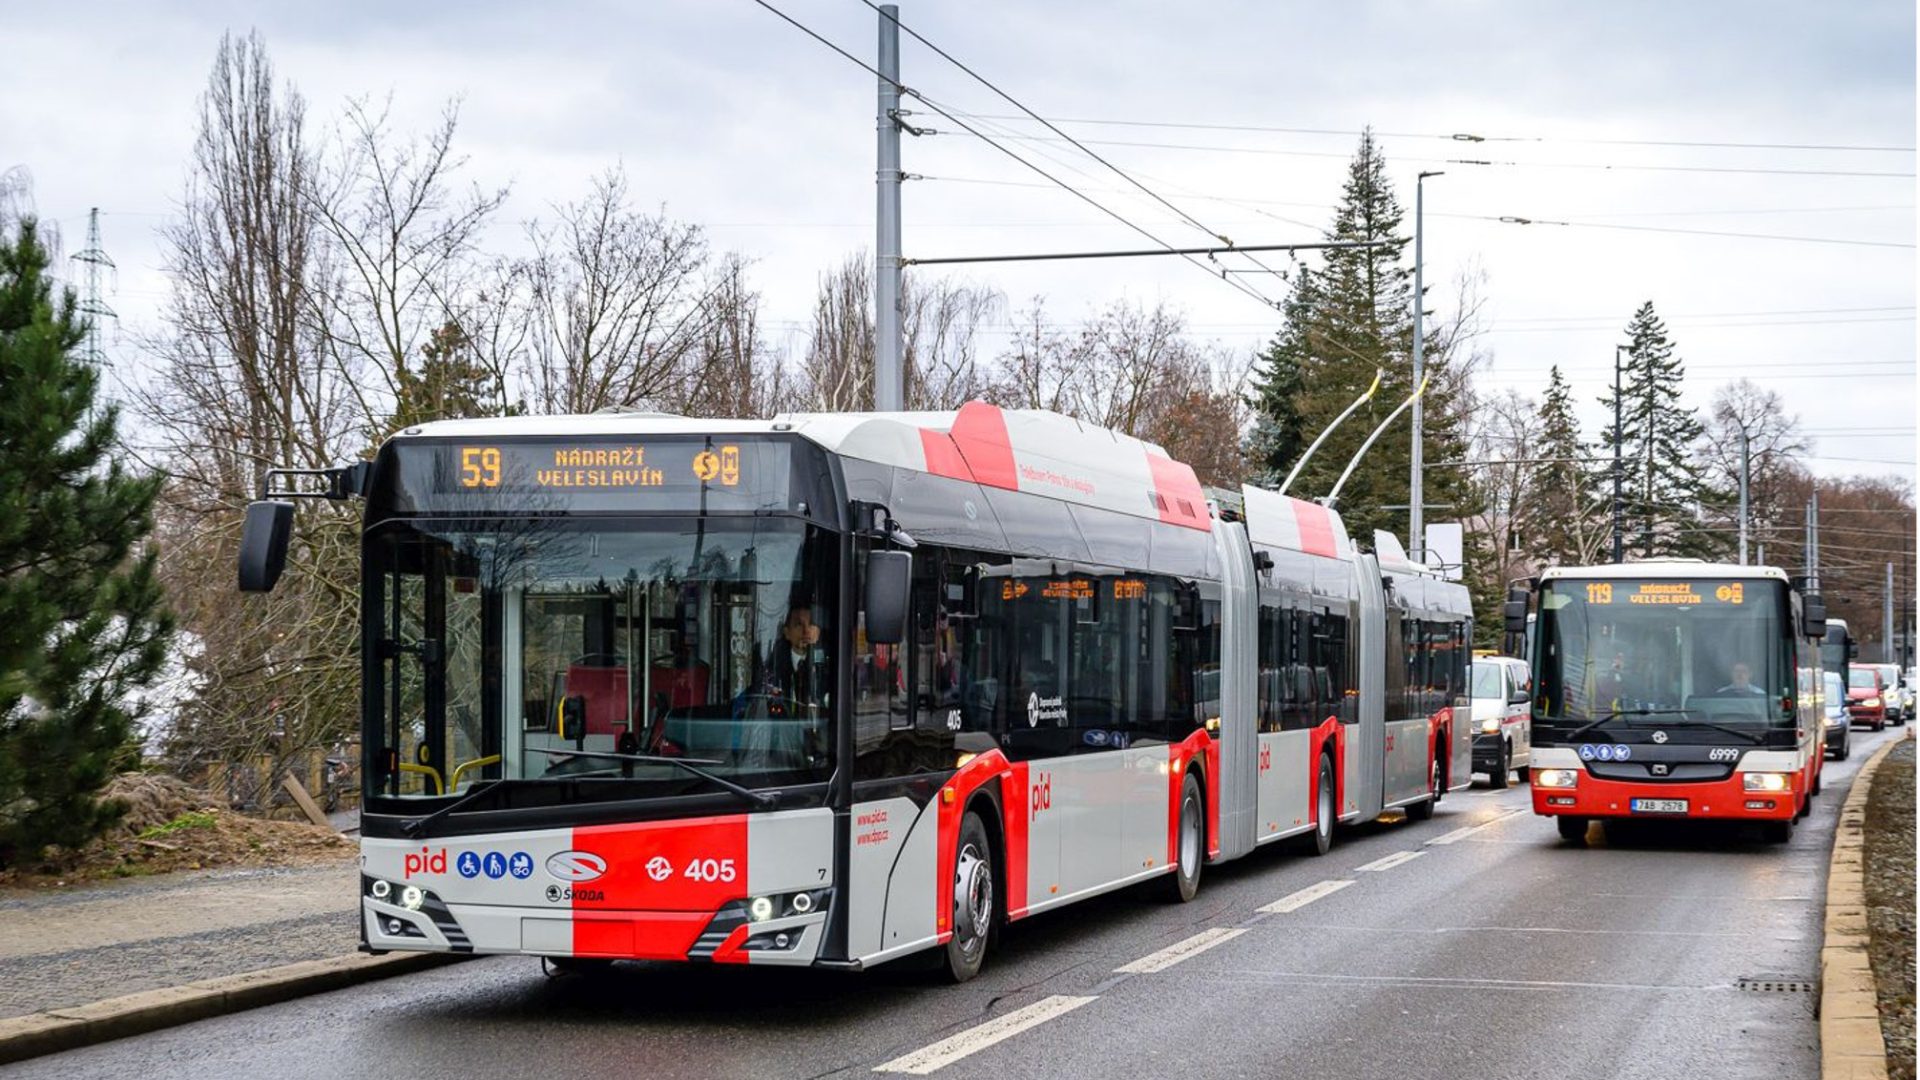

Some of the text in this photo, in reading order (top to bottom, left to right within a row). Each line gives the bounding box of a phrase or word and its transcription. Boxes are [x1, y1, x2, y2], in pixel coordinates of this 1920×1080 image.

[462, 447, 500, 487] 59
[555, 447, 645, 466] NÁDRAŽÍ
[537, 467, 664, 486] VELESLAVÍN
[1586, 582, 1612, 604] 119
[947, 709, 962, 730] 405
[1709, 748, 1739, 761] 6999
[1032, 771, 1051, 821] pid
[405, 847, 447, 879] pid
[684, 858, 736, 882] 405
[818, 868, 827, 881] 7
[563, 886, 605, 902] ŠKODA
